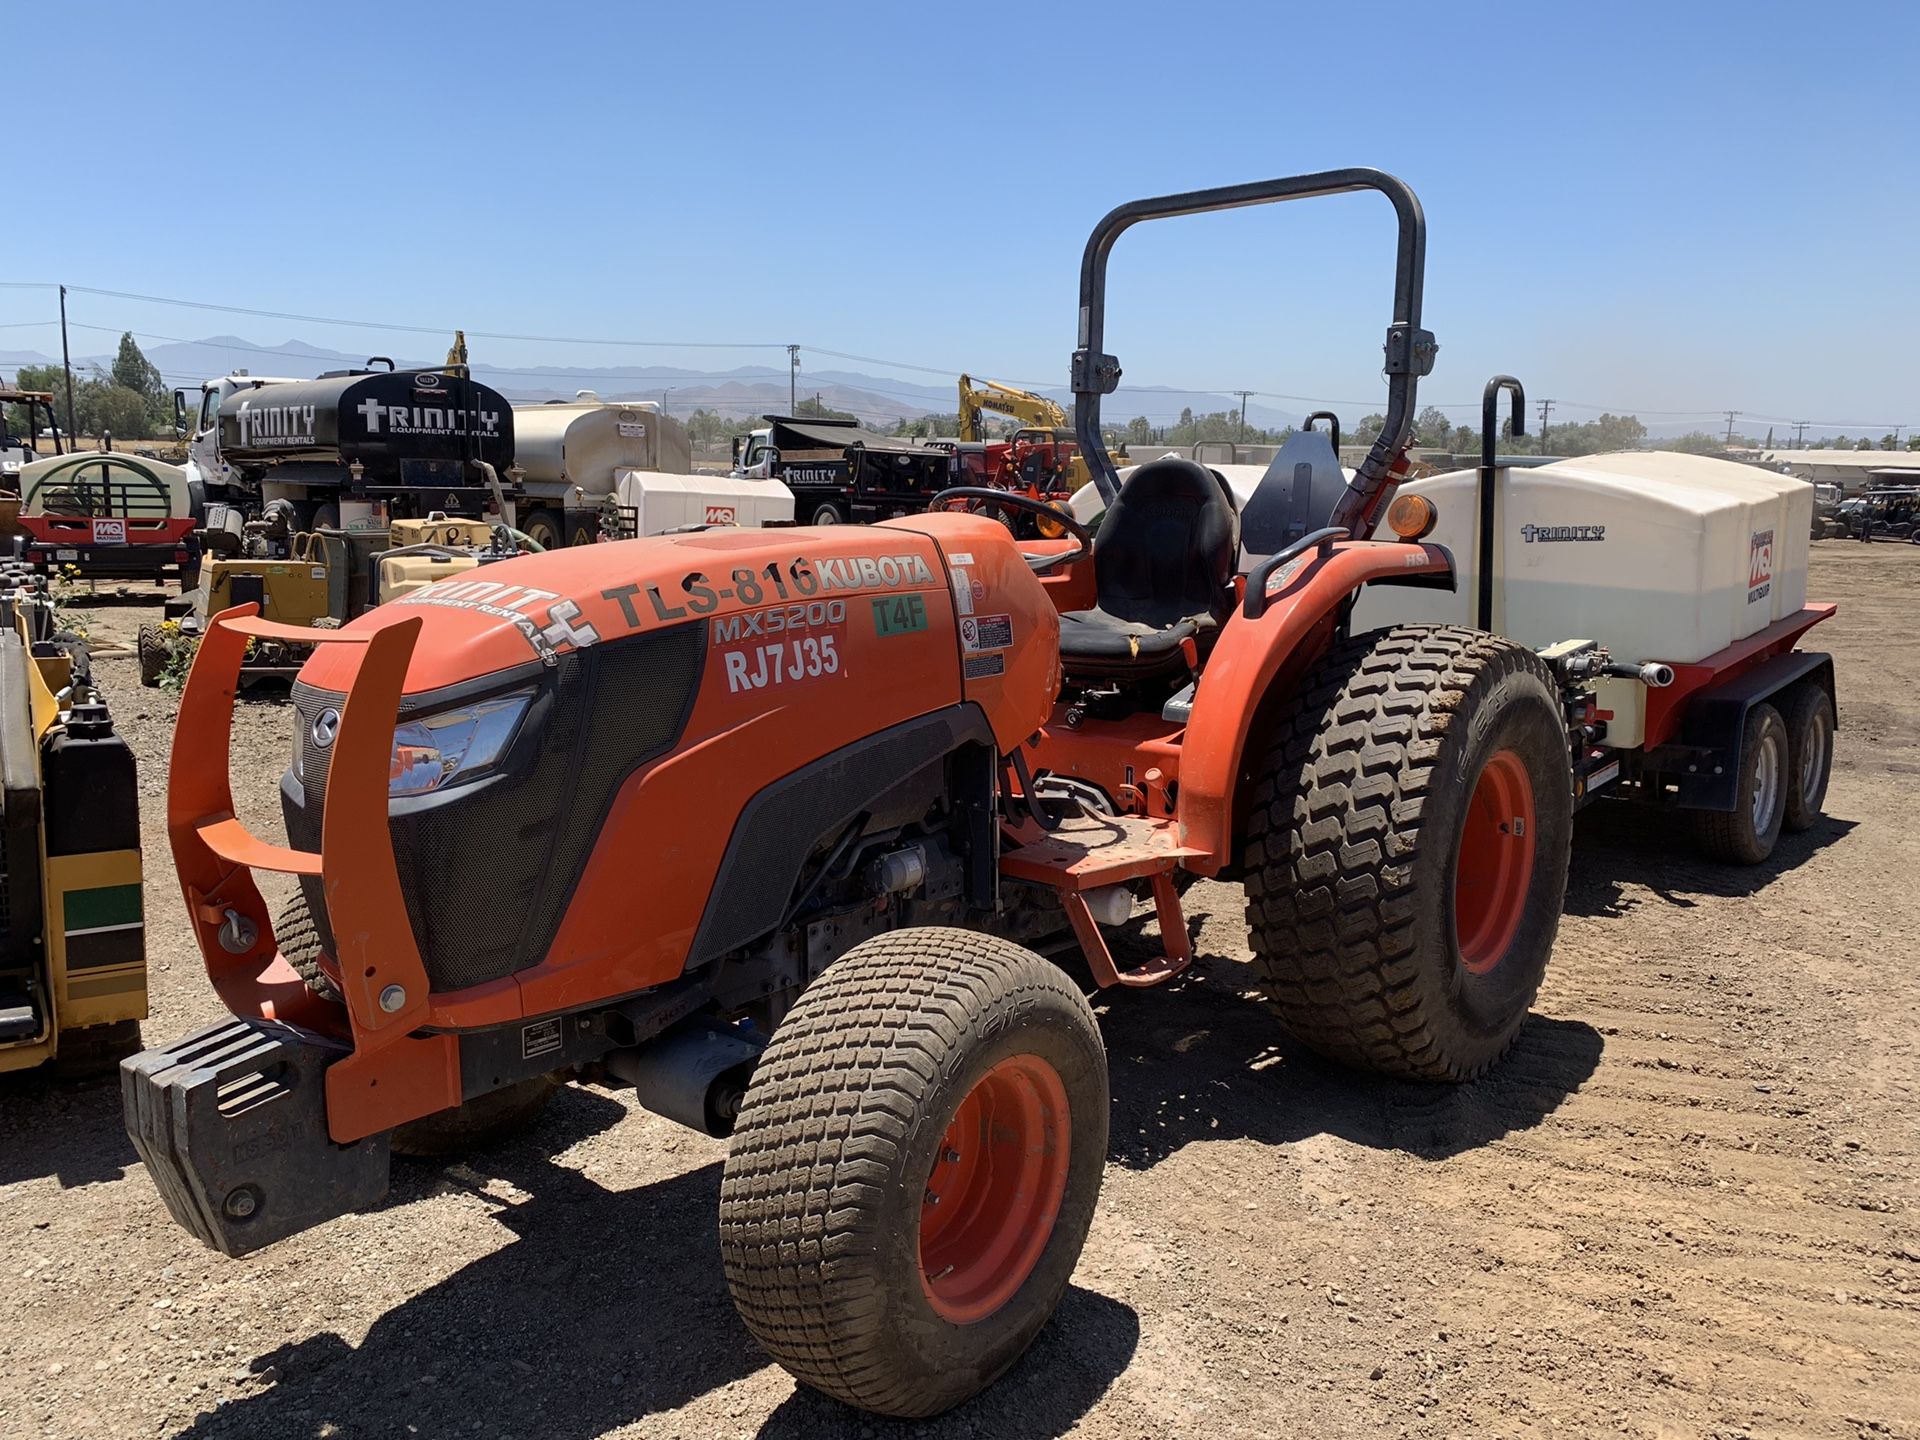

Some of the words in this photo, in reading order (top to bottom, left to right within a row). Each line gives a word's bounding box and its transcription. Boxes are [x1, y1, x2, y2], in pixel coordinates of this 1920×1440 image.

[983, 399, 1015, 413] KOMATSU
[390, 426, 452, 436] EQUIPMENT
[252, 437, 286, 446] EQUIPMENT
[286, 436, 315, 445] RENTALS
[705, 508, 734, 524] MQ
[96, 522, 123, 535] MQ
[600, 556, 818, 629] TLS-816
[814, 555, 935, 590] KUBOTA
[872, 595, 923, 632] T4F
[714, 599, 846, 645] MX5200
[724, 635, 840, 694] RJ7J35
